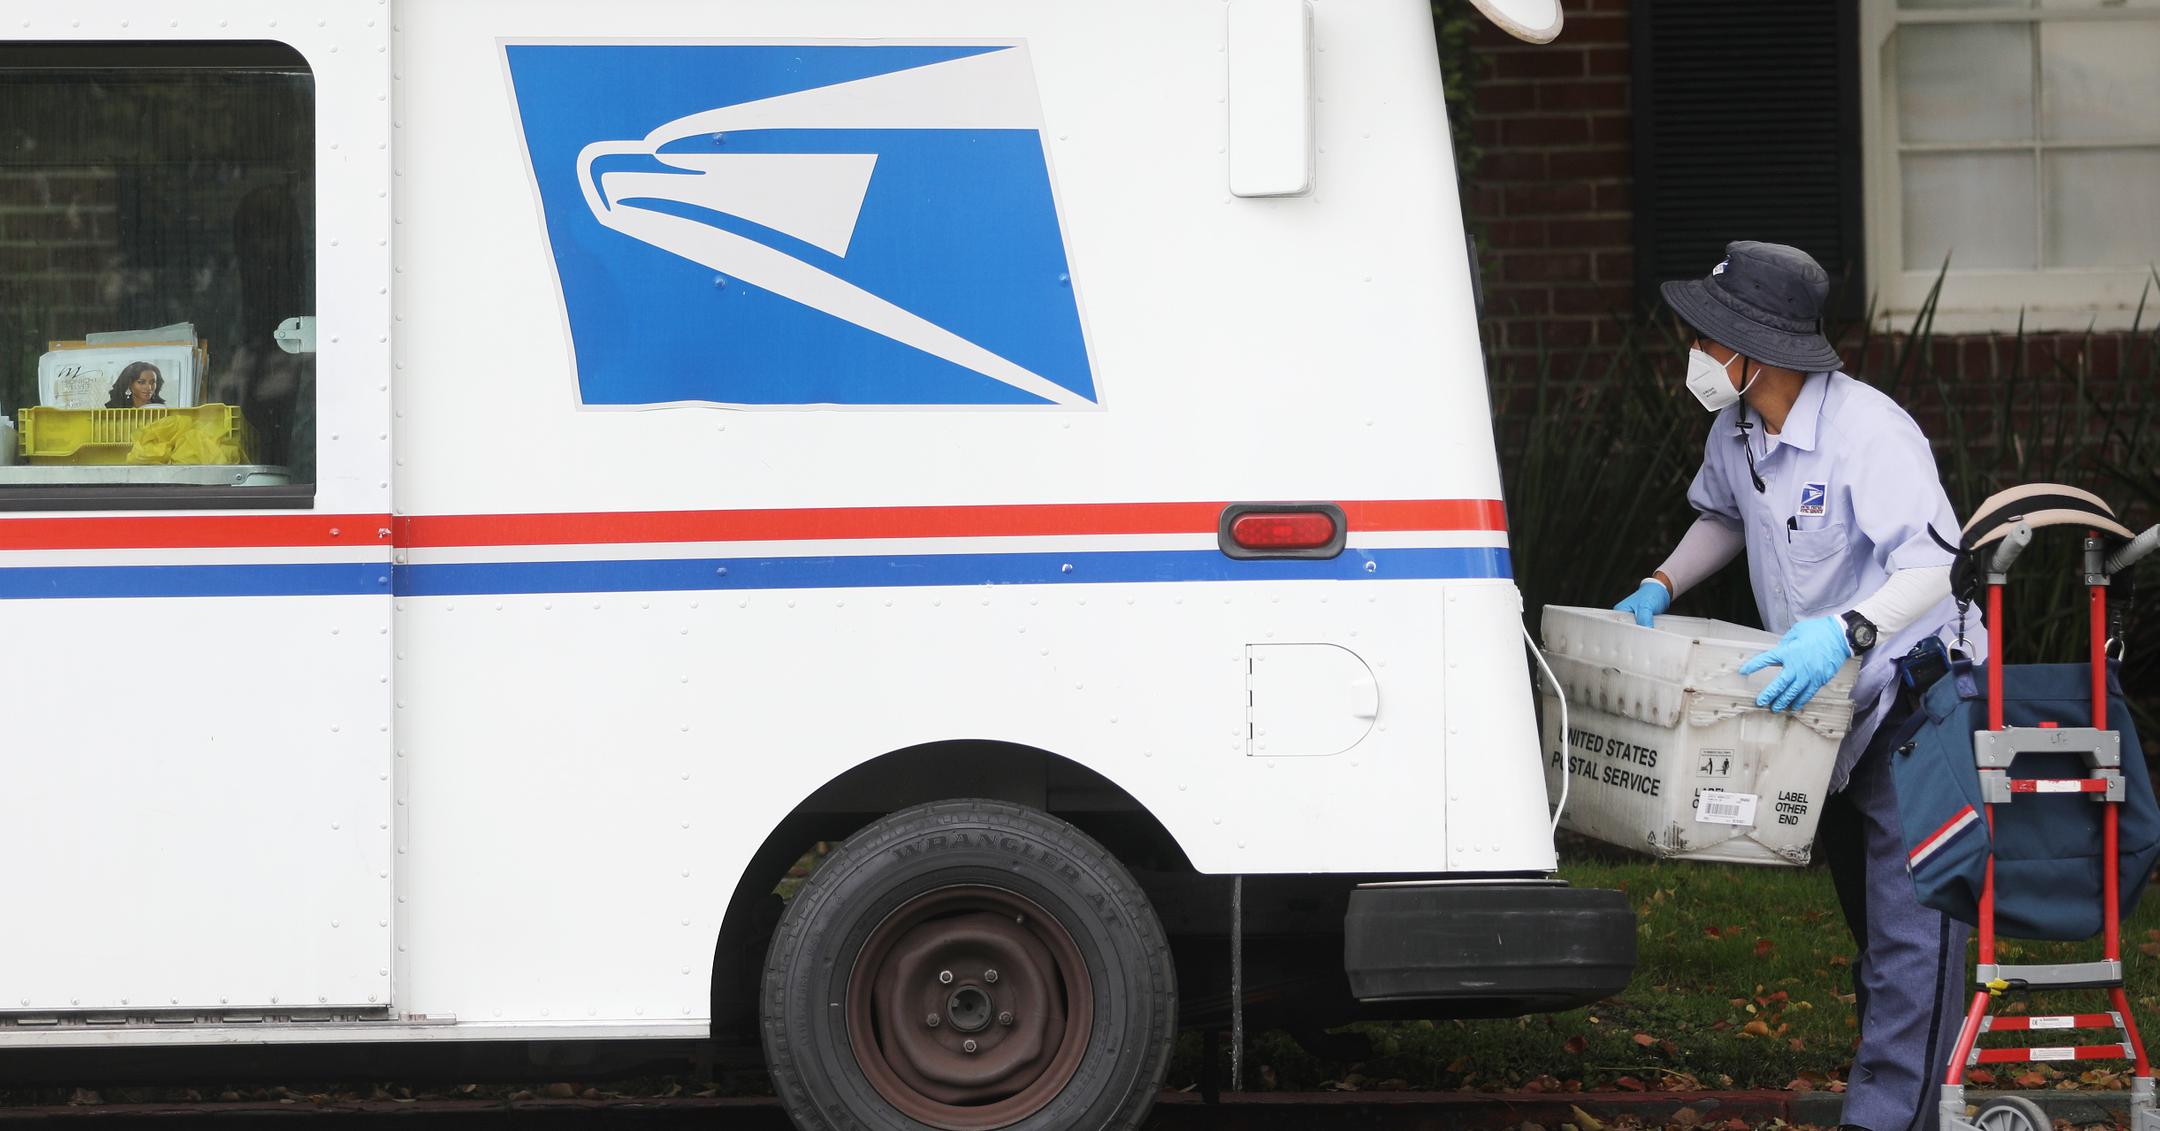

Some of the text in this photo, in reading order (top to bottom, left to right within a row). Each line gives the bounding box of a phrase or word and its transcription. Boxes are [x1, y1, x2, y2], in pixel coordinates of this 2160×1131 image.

[1606, 738, 1658, 768] STATES
[1603, 766, 1661, 797] SERVICE
[1778, 790, 1809, 804] LABEL
[1775, 802, 1808, 815] OTHER
[1778, 814, 1799, 826] END
[894, 833, 1082, 884] WRANGLER
